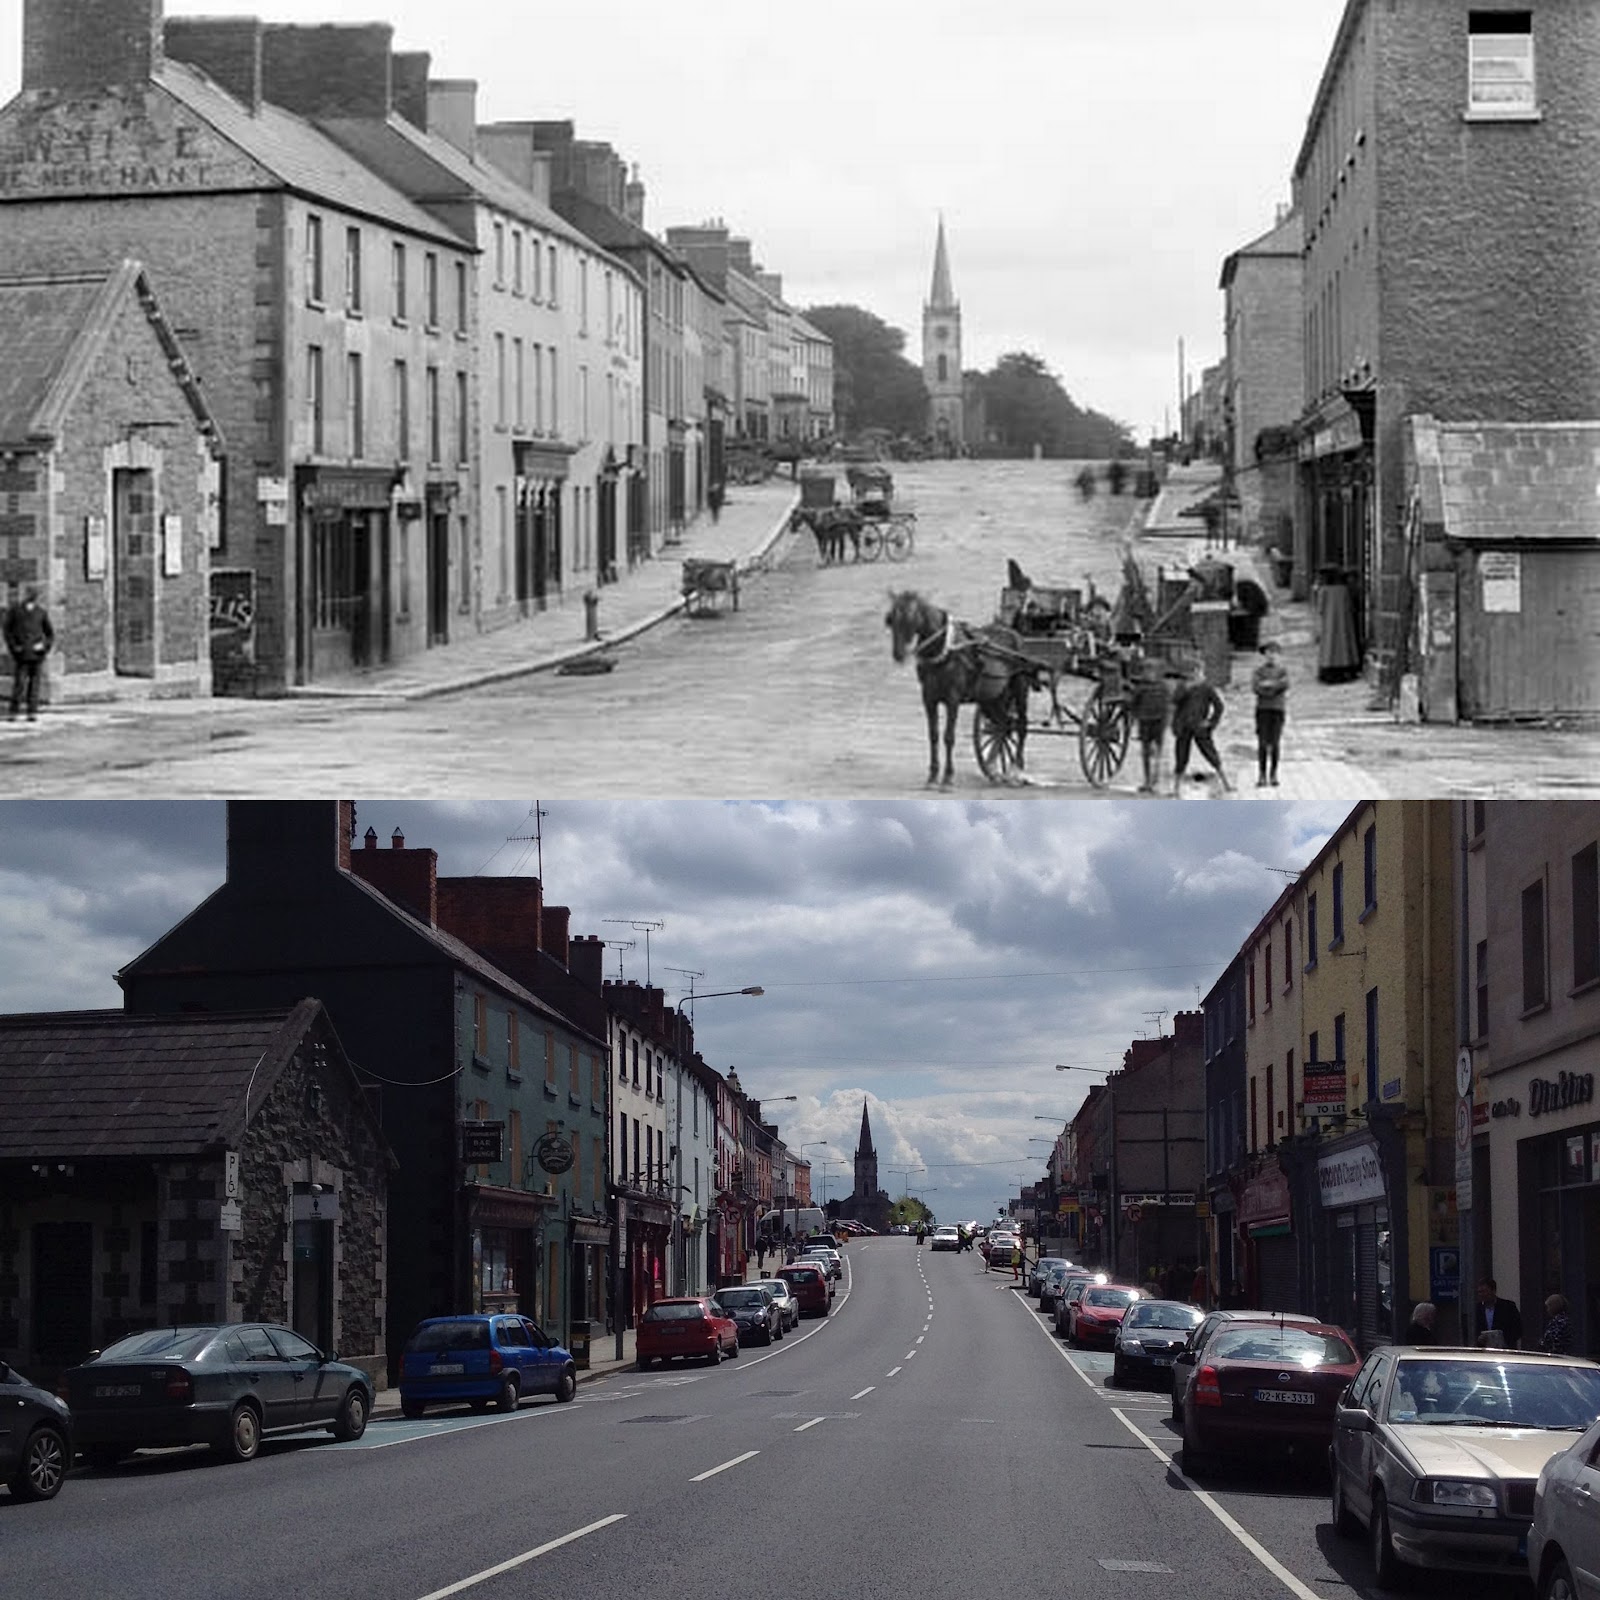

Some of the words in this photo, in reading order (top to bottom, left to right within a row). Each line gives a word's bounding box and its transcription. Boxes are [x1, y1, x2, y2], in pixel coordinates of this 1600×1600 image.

[1317, 1105, 1329, 1113] TO
[1332, 1104, 1345, 1113] LET
[473, 1139, 492, 1147] BAR
[468, 1150, 495, 1158] LOUNGE
[229, 1155, 236, 1169] P
[1259, 1391, 1313, 1404] 02-KE-3331
